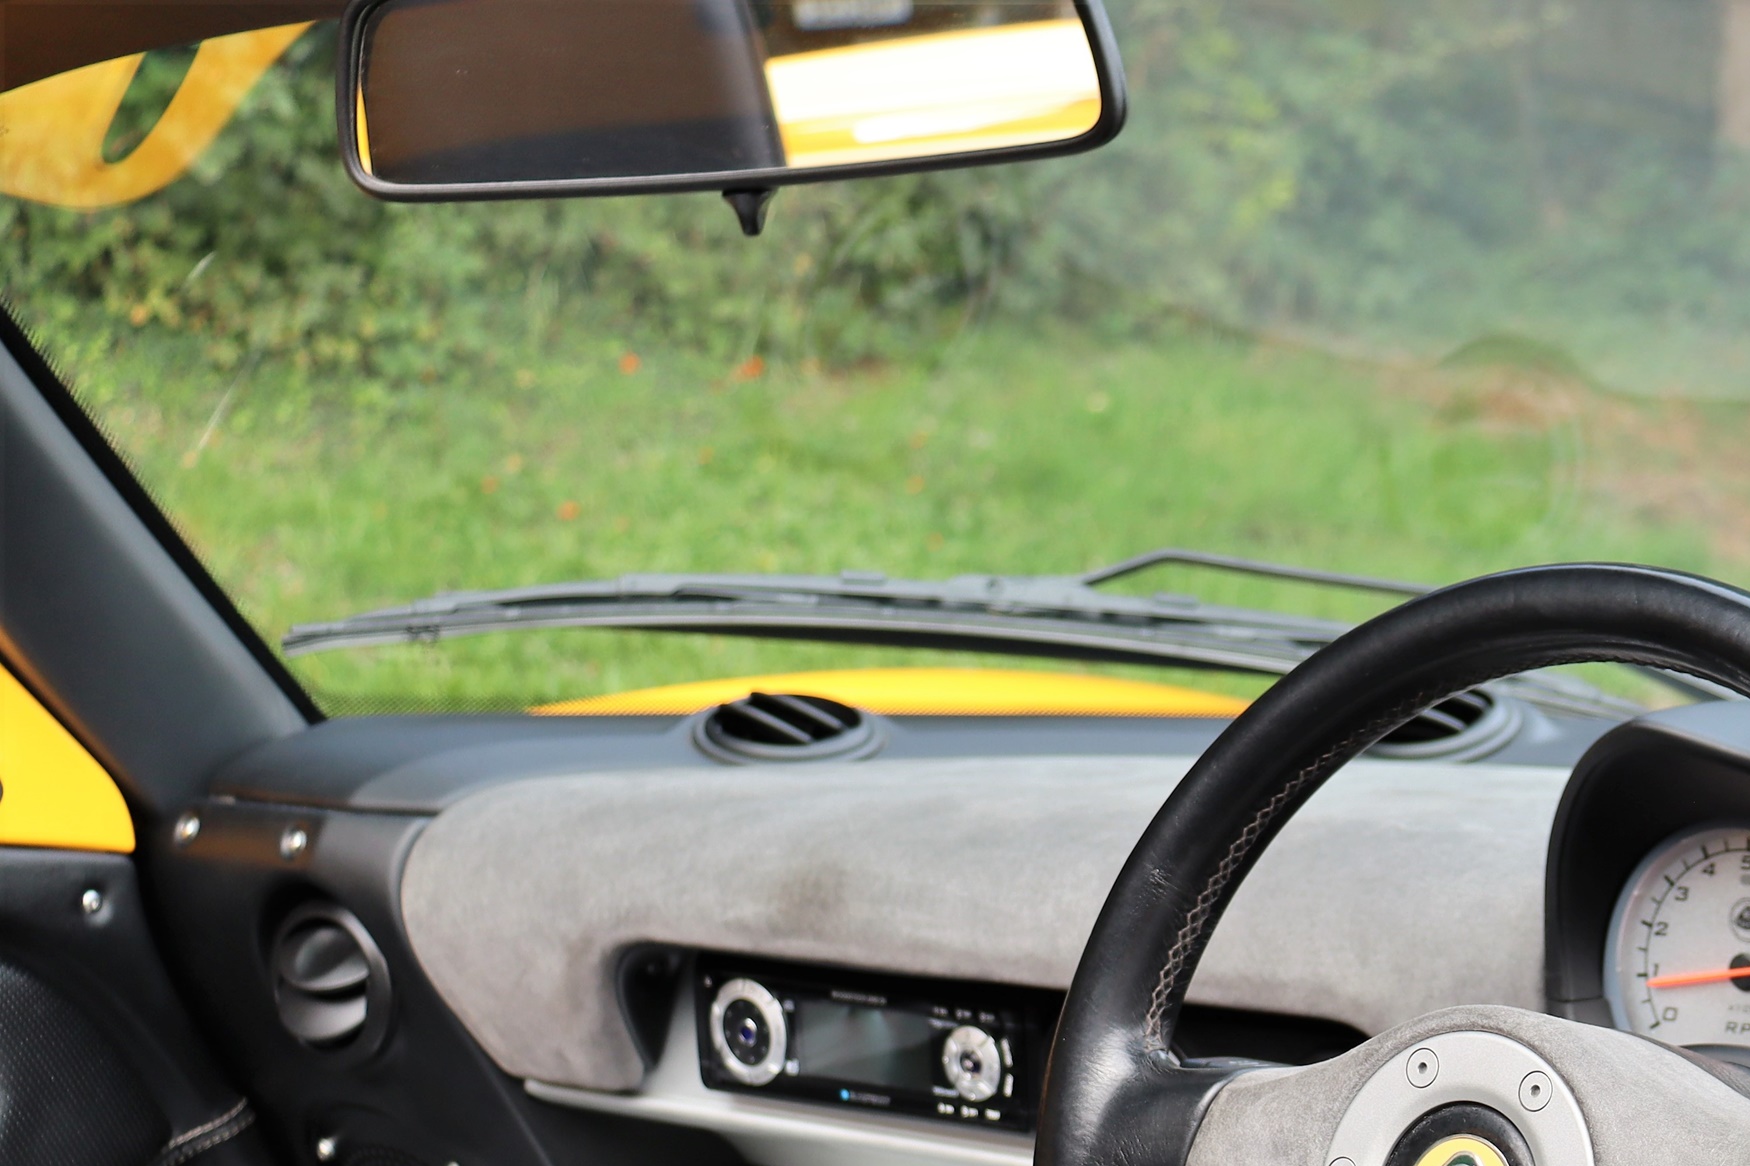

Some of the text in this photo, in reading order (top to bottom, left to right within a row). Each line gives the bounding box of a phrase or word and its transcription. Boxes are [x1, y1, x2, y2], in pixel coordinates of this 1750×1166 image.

[1702, 863, 1716, 876] 4
[1675, 886, 1689, 901] 3
[1654, 922, 1669, 936] 2
[1662, 1006, 1678, 1021] 0
